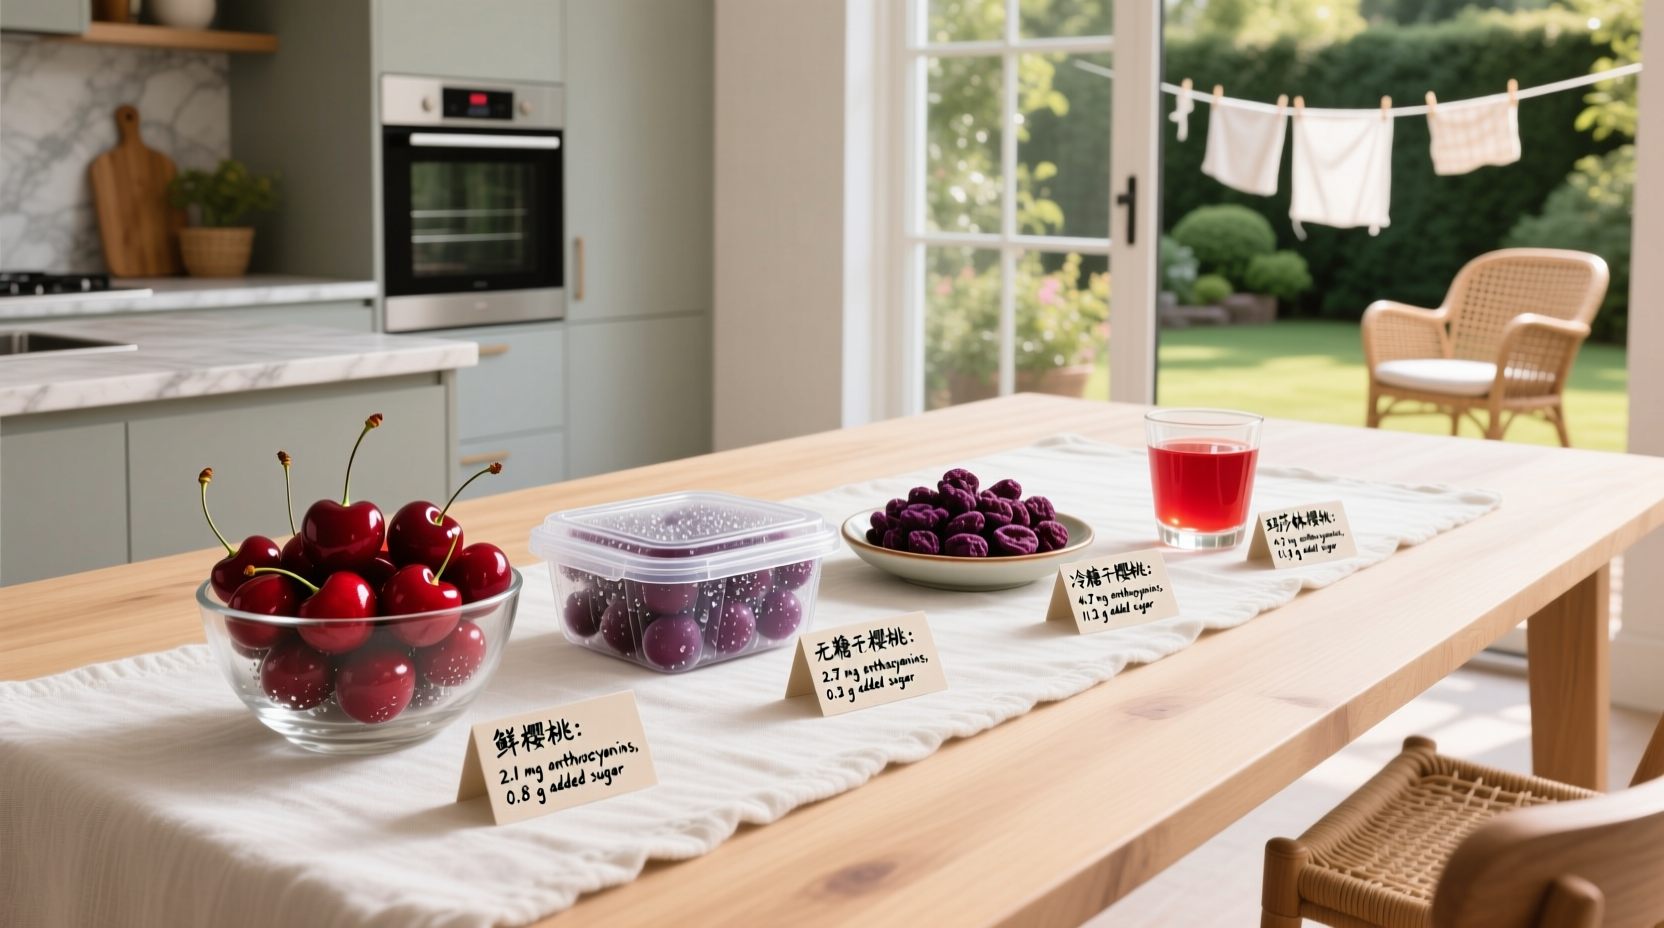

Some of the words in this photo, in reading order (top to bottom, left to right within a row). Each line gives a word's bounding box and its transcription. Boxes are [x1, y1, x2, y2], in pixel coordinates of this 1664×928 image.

[1102, 610, 1109, 624] g
[821, 667, 840, 683] 2.7
[844, 668, 861, 683] mg
[847, 687, 856, 703] g
[499, 765, 519, 785] 2.1
[524, 766, 544, 783] mg
[506, 785, 531, 806] 0.8
[536, 787, 547, 805] g
[549, 769, 586, 793] added
[590, 765, 625, 786] sugar
